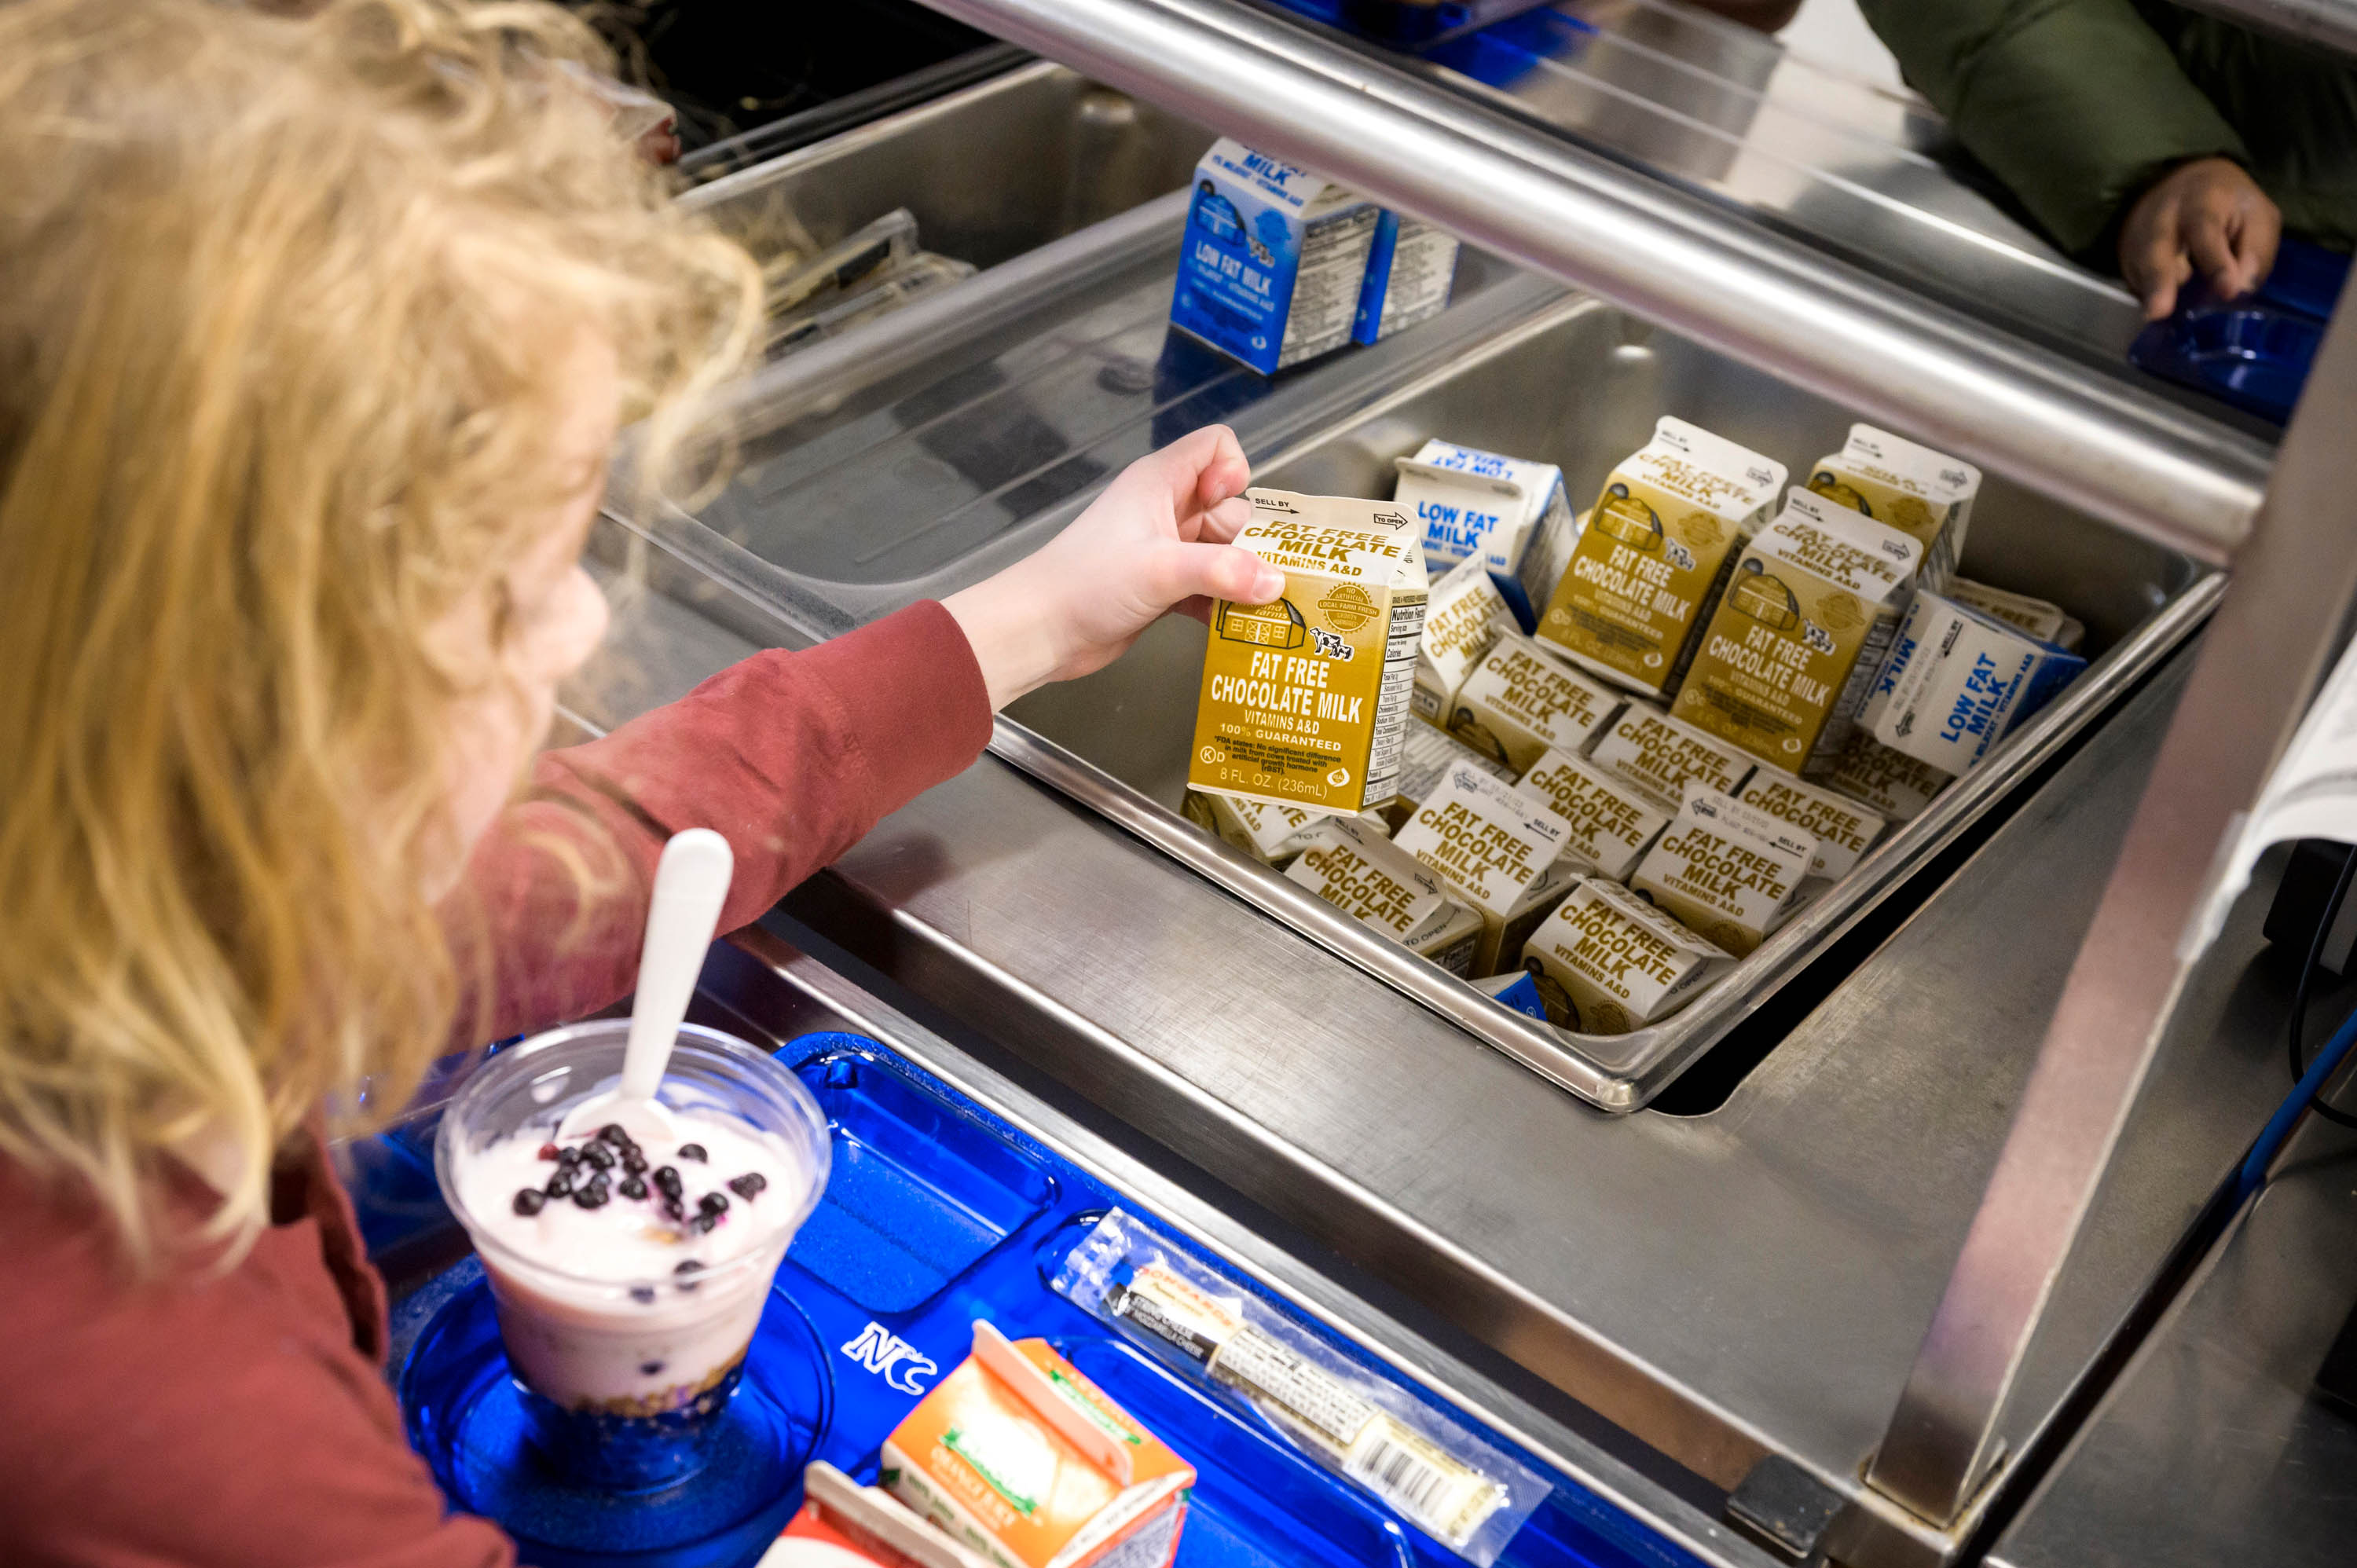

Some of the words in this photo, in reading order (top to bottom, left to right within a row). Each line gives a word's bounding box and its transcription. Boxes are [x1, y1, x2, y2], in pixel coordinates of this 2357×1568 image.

[1242, 154, 1291, 185] MILK
[1196, 240, 1220, 268] LOW
[1221, 255, 1242, 279] FAT
[1242, 266, 1272, 296] MILK
[1255, 498, 1276, 507] SELL
[1418, 501, 1460, 522] LOW
[1464, 510, 1499, 533] FAT
[1244, 527, 1402, 559] CHOCOLATE
[1269, 520, 1317, 534] FAT
[1326, 529, 1389, 544] FREE
[1277, 540, 1351, 562] MILK
[1428, 523, 1479, 549] MILK
[1257, 551, 1326, 571] VITAMINS
[1329, 562, 1362, 577] A&D
[1610, 544, 1638, 571] FAT
[1634, 555, 1673, 588] FREE
[1778, 548, 1832, 577] VITAMINS
[1835, 574, 1860, 589] A&D
[1797, 544, 1851, 576] MILK
[1574, 555, 1655, 606] CHOCOLATE
[1651, 589, 1690, 621] MILK
[1358, 606, 1377, 615] FRESH
[1392, 607, 1413, 621] Nutrition
[1428, 611, 1452, 637] FAT
[1452, 587, 1487, 617] FREE
[1430, 595, 1505, 658] CHOCOLATE
[1387, 649, 1401, 658] Calories
[1459, 625, 1496, 658] MILK
[1745, 625, 1775, 652] FAT
[1773, 638, 1813, 671] FREE
[1250, 650, 1282, 677] FAT
[1285, 659, 1330, 689] FREE
[1509, 650, 1545, 676] FAT
[1545, 672, 1594, 706] FREE
[1709, 635, 1791, 690] CHOCOLATE
[1790, 669, 1833, 707] MILK
[1879, 637, 1915, 695] MILK
[1211, 674, 1313, 716] CHOCOLATE
[1317, 694, 1363, 724] MILK
[1486, 657, 1596, 727] CHOCOLATE
[1502, 686, 1555, 724] MILK
[1940, 694, 1975, 742] LOW
[1966, 652, 1996, 694] FAT
[1966, 676, 2007, 736] MILK
[1220, 724, 1251, 737] 100%
[1255, 730, 1342, 752] GUARANTEED
[1244, 709, 1294, 731] VITAMINS
[1296, 719, 1320, 735] A&D
[1641, 716, 1678, 742] FAT
[1677, 738, 1731, 771] FREE
[1232, 753, 1259, 763] artificial
[1261, 759, 1285, 768] growth
[1286, 763, 1318, 773] hormone
[1233, 739, 1255, 749] states:
[1268, 746, 1305, 758] significant
[1306, 752, 1342, 763] difference
[1286, 755, 1310, 764] treated
[1313, 759, 1328, 768] with
[1618, 723, 1732, 792] CHOCOLATE
[1635, 752, 1690, 789] MILK
[1220, 768, 1227, 779] 8
[1231, 769, 1248, 783] FL.
[1253, 773, 1274, 788] OZ.
[1277, 778, 1328, 799] (236mL)
[1554, 764, 1593, 791] FAT
[1590, 787, 1643, 824] FREE
[1616, 758, 1665, 792] VITAMINS
[1667, 789, 1684, 802] A&
[1530, 770, 1643, 848] CHOCOLATE
[1534, 819, 1549, 832] SELL
[1549, 829, 1560, 837] BY
[1549, 800, 1602, 842] MILK
[1744, 789, 1867, 853] CHOCOLATE
[1766, 782, 1807, 806] FAT
[1806, 800, 1861, 832] FREE
[1419, 809, 1534, 885] CHOCOLATE
[1443, 801, 1482, 828] FAT
[1479, 823, 1533, 862] FREE
[1575, 841, 1600, 859] A&D
[1685, 827, 1725, 852] FAT
[1726, 845, 1783, 878] FREE
[1778, 836, 1794, 847] SELL
[1329, 844, 1368, 874] FAT
[1364, 869, 1416, 909] FREE
[1416, 849, 1467, 885] VITAMINS
[1466, 882, 1490, 899] A&D
[1434, 840, 1492, 883] MILK
[1662, 836, 1787, 900] CHOCOLATE
[1682, 864, 1743, 901] MILK
[1304, 851, 1413, 933] CHOCOLATE
[1663, 873, 1717, 905] VITAMINS
[1718, 899, 1744, 917] A&D
[1405, 938, 1420, 947] TO
[1420, 924, 1446, 941] OPEN
[1560, 905, 1677, 986] CHOCOLATE
[1584, 899, 1626, 927] FAT
[1622, 923, 1677, 963] FREE
[1554, 943, 1605, 982] VITAMINS
[1605, 980, 1630, 999] A&D
[1574, 936, 1632, 981] MILK
